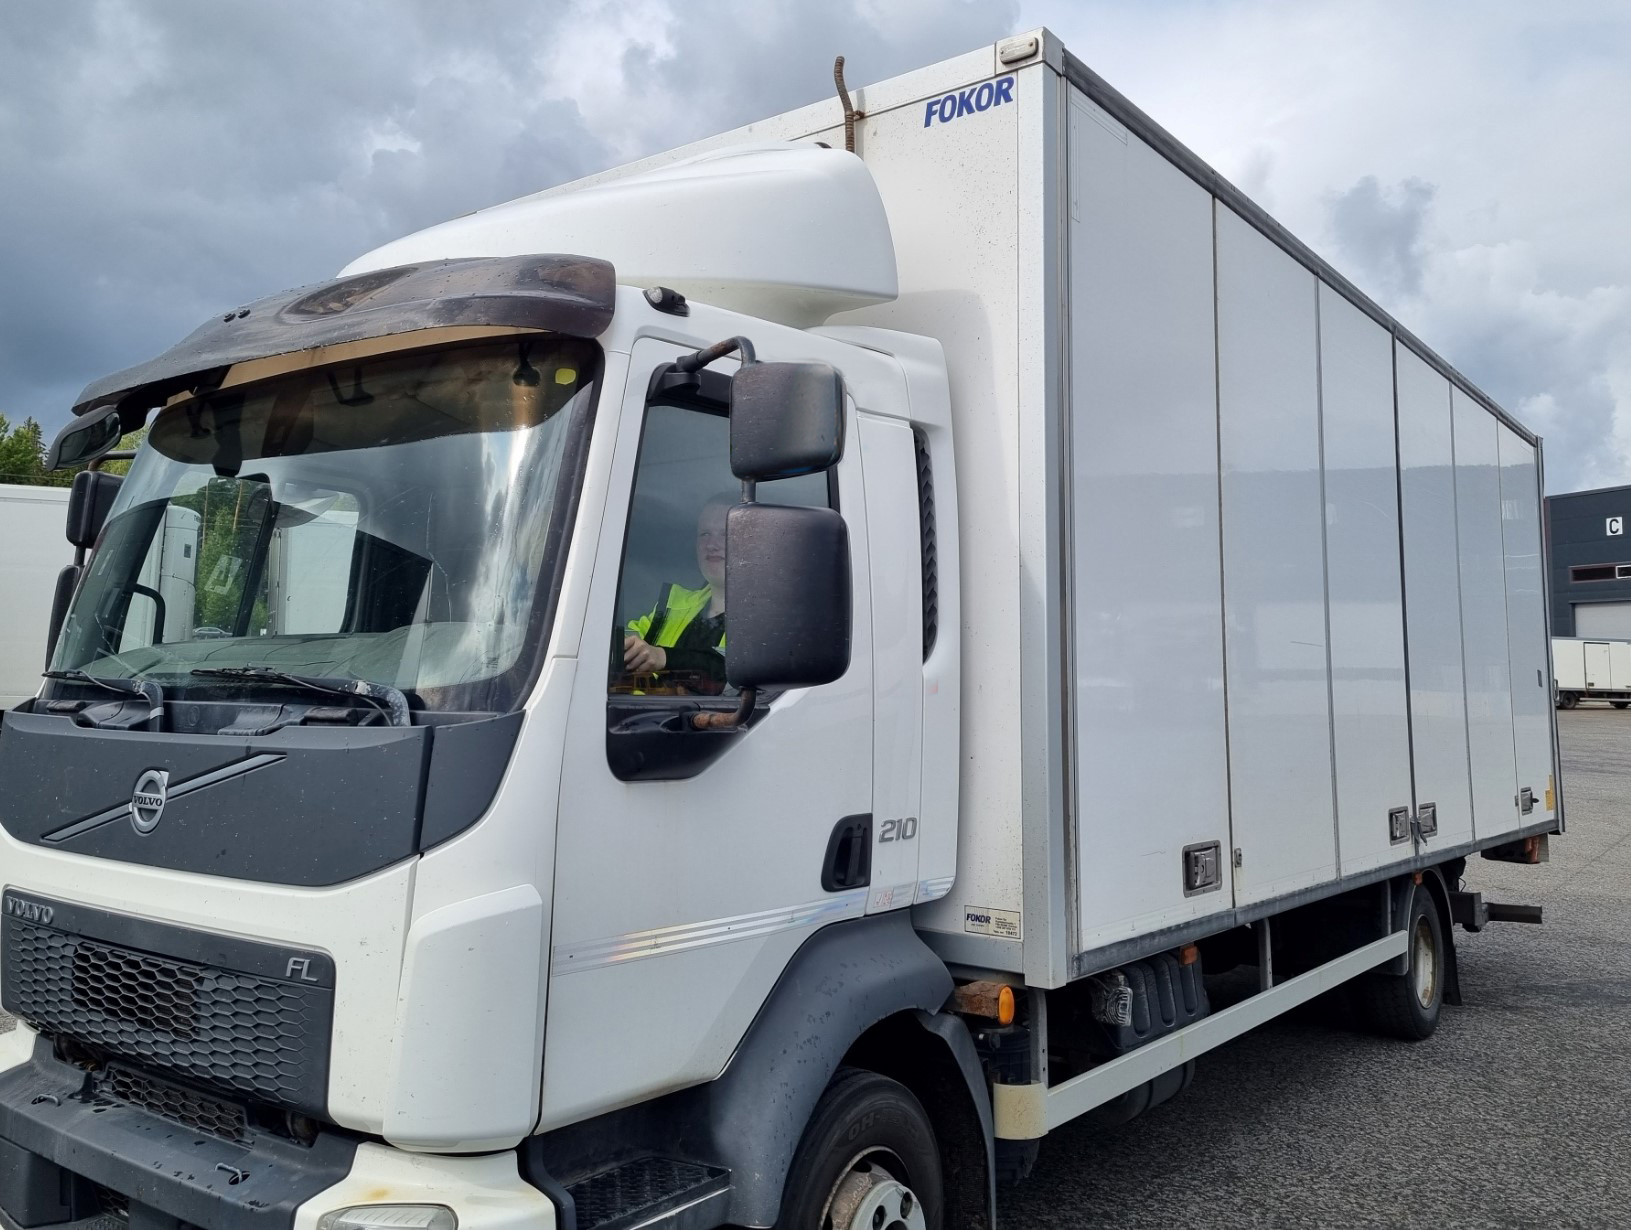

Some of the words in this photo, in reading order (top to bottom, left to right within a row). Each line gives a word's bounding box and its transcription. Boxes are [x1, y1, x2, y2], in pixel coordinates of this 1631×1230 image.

[924, 76, 1014, 128] FOKOR
[1609, 518, 1619, 534] C
[133, 795, 163, 807] VOLVO
[878, 817, 917, 843] 210
[6, 895, 54, 924] VOLVO
[966, 913, 991, 924] FOKOR
[285, 956, 319, 981] FL
